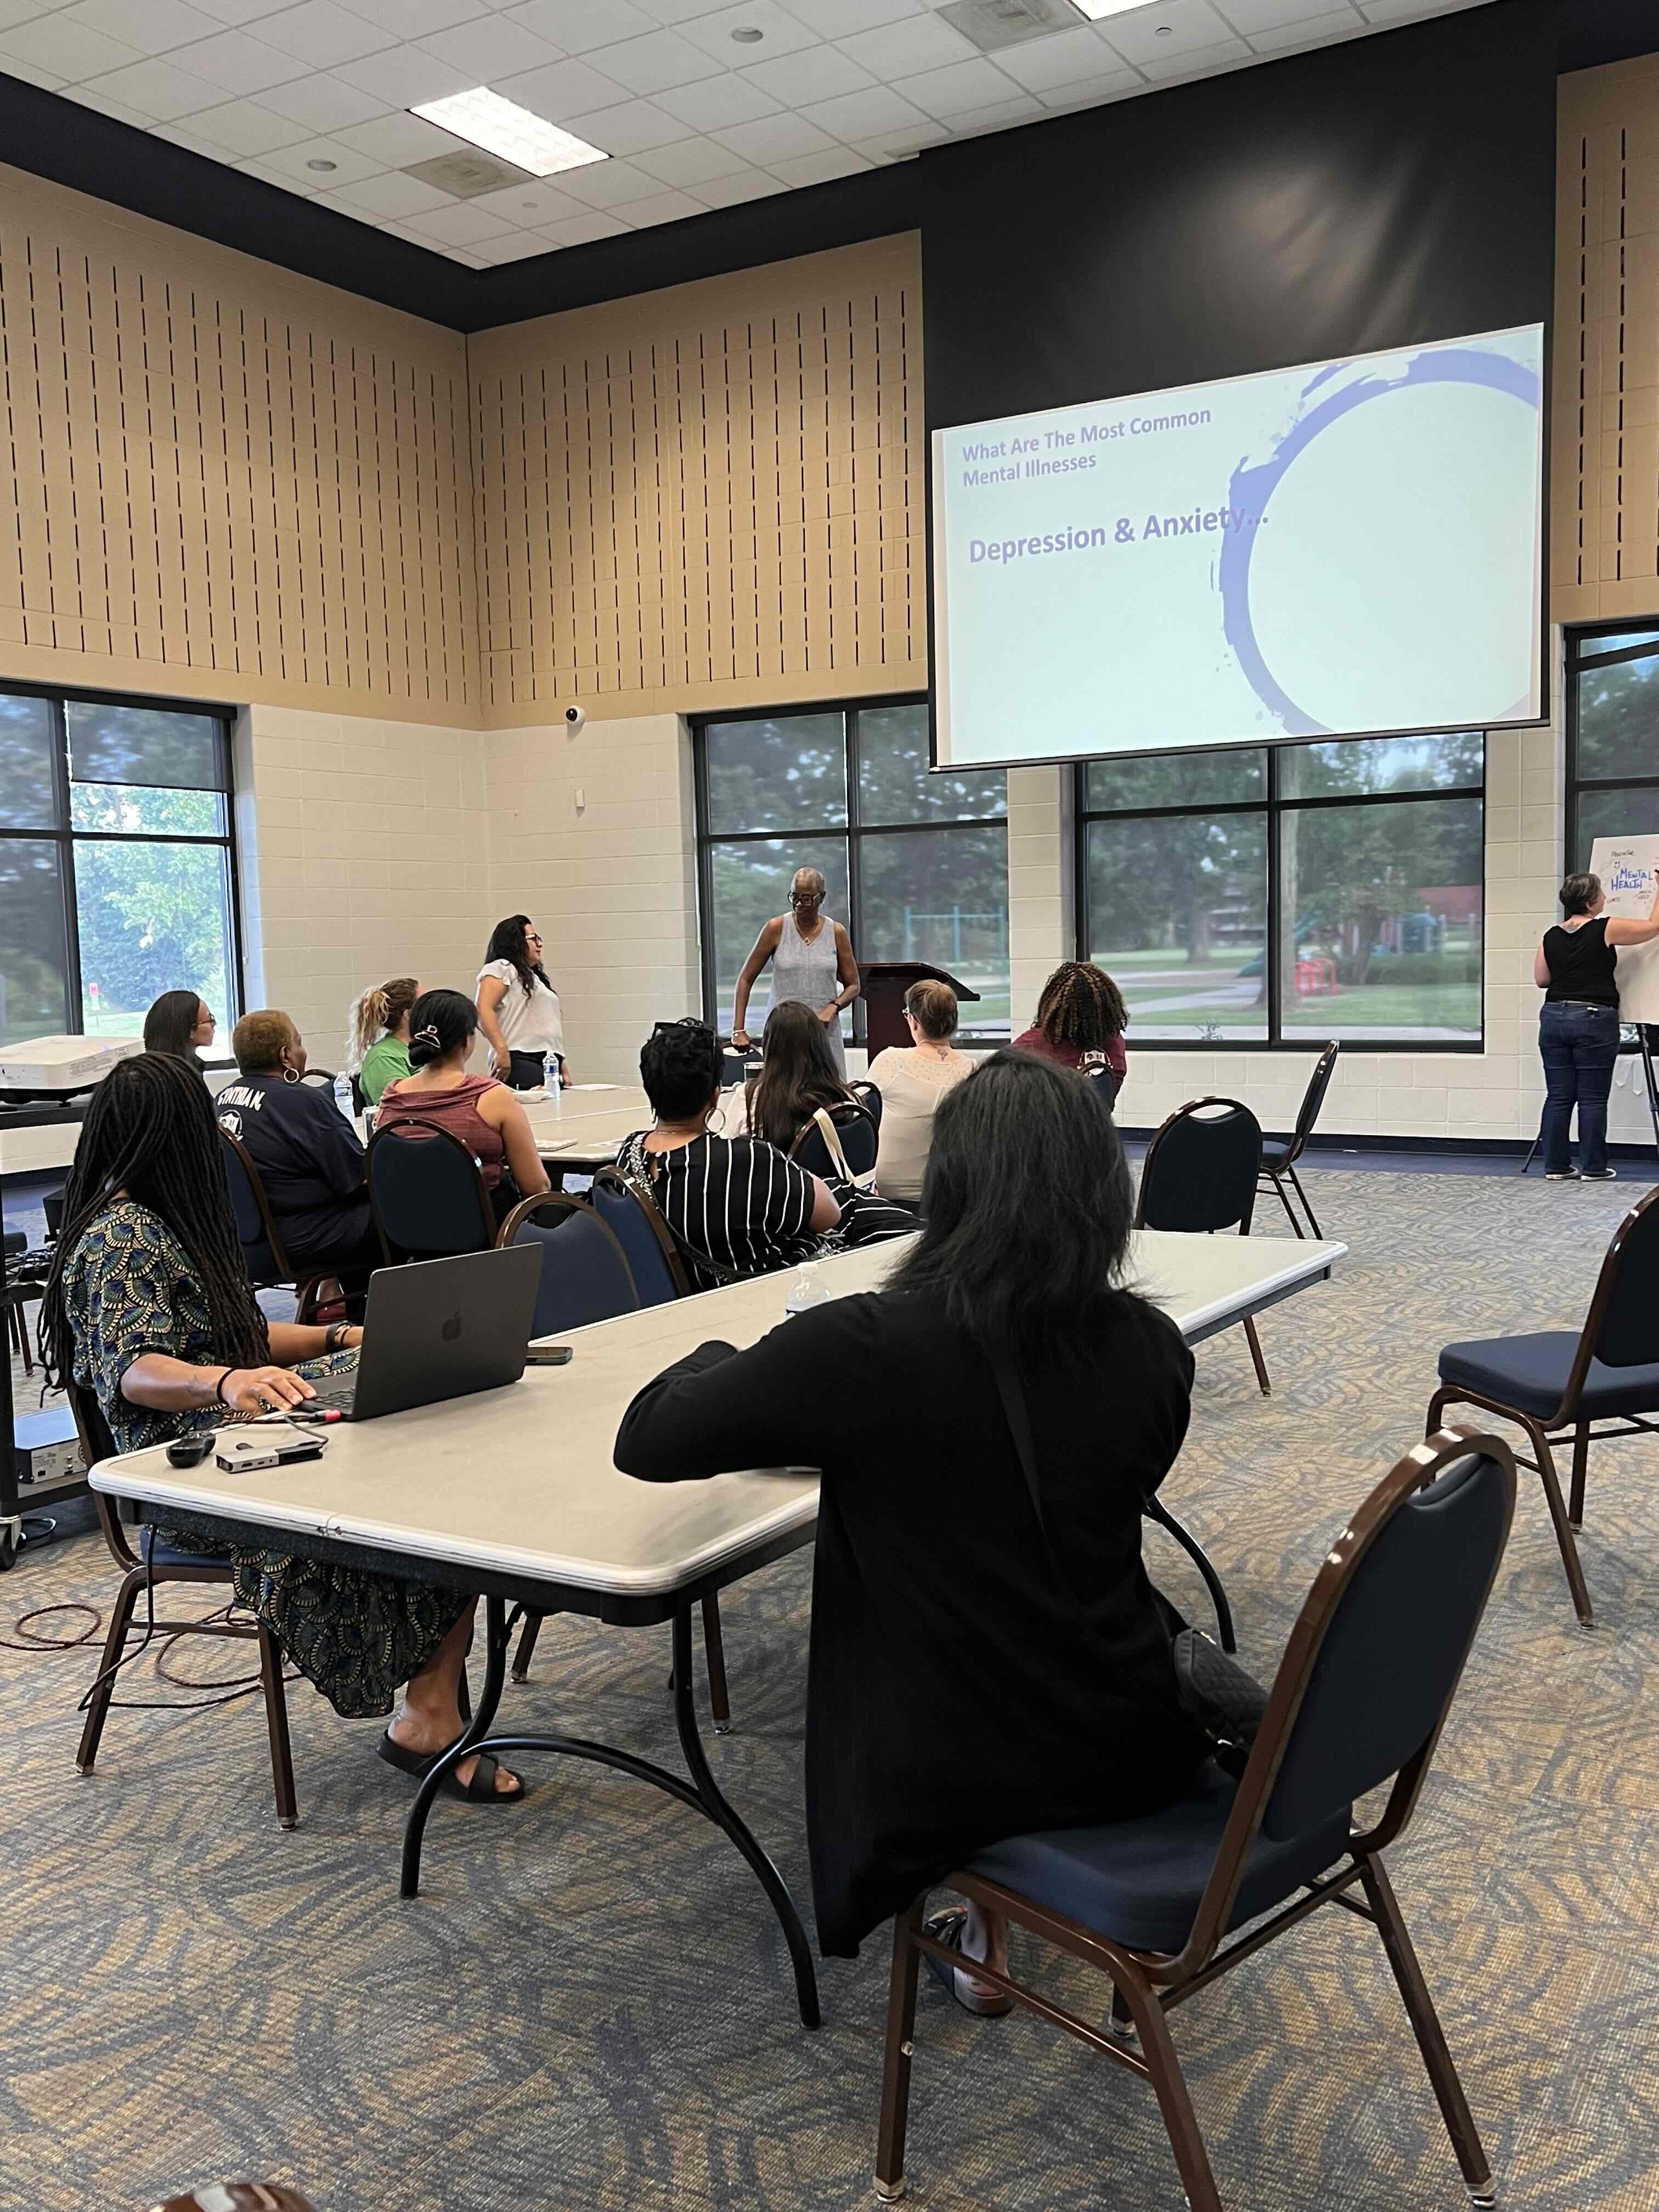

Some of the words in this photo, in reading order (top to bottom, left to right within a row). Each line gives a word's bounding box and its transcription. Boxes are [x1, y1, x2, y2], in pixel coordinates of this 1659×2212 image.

[963, 441, 1006, 461] What
[1011, 437, 1040, 454] Are
[1045, 430, 1075, 449] The
[1081, 422, 1125, 443] Most
[1130, 409, 1211, 435] Common
[963, 462, 1020, 487] Mental
[1025, 453, 1097, 478] Illnesses
[969, 524, 1106, 565] Depression
[1114, 518, 1135, 543] &
[1611, 874, 1642, 891] HEALTH
[1620, 868, 1654, 880] MENTAL
